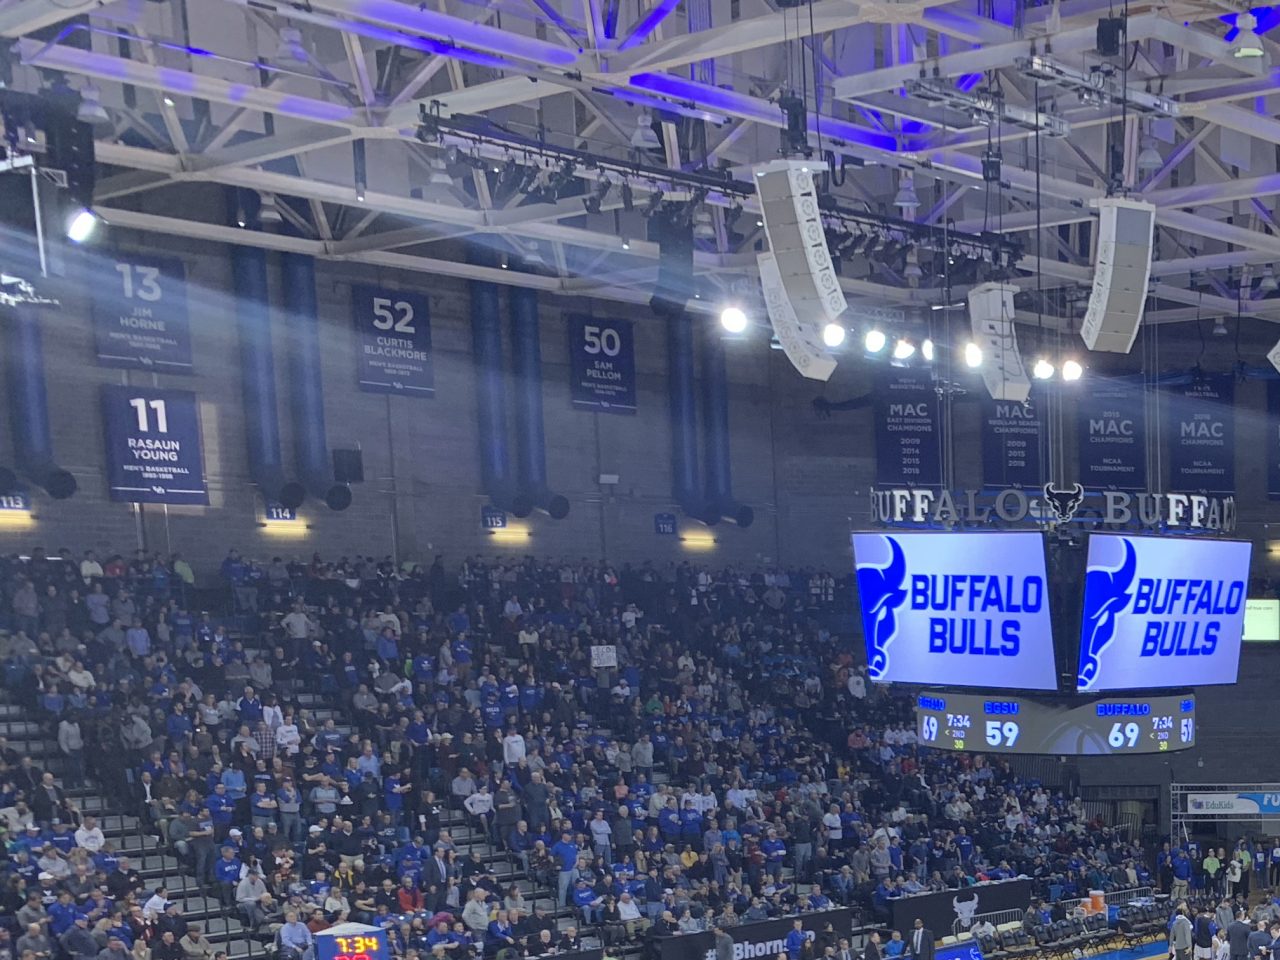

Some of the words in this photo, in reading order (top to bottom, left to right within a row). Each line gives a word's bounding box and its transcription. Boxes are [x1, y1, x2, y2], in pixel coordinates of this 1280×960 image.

[115, 263, 162, 301] 13
[131, 307, 153, 318] JIM
[373, 297, 415, 334] 52
[120, 317, 166, 331] HORNE
[377, 336, 414, 349] CURTIS
[584, 325, 621, 356] 50
[364, 345, 428, 361] BLACKMORE
[594, 360, 613, 370] SAM
[586, 369, 621, 380] PELLOM
[129, 398, 168, 433] 11
[890, 403, 928, 416] MAC
[996, 405, 1034, 418] MAC
[1090, 420, 1133, 435] MAC
[1181, 422, 1224, 437] MAC
[127, 438, 180, 450] RASAUN
[132, 450, 178, 461] YOUNG
[1, 496, 24, 508] 113
[870, 488, 1029, 523] BUFFALO
[271, 508, 291, 519] 114
[1103, 490, 1237, 531] BUFFALO
[487, 517, 502, 527] 115
[659, 523, 673, 533] 116
[911, 574, 1043, 613] BUFFALO
[1131, 578, 1244, 615] BUFFALO
[928, 617, 1021, 656] BULLS
[1140, 621, 1220, 657] BULLS
[984, 701, 1019, 715] BGSU
[1097, 703, 1151, 716] BUFFALO
[946, 713, 970, 728] 7:34
[1152, 716, 1173, 730] 7:34
[923, 715, 938, 741] 69
[952, 730, 965, 738] 2ND
[985, 720, 1019, 747] 59
[1108, 722, 1139, 748] 69
[1181, 718, 1193, 742] 59
[954, 740, 964, 749] 30
[1205, 801, 1234, 810] EduKids
[336, 936, 378, 953] 7:34
